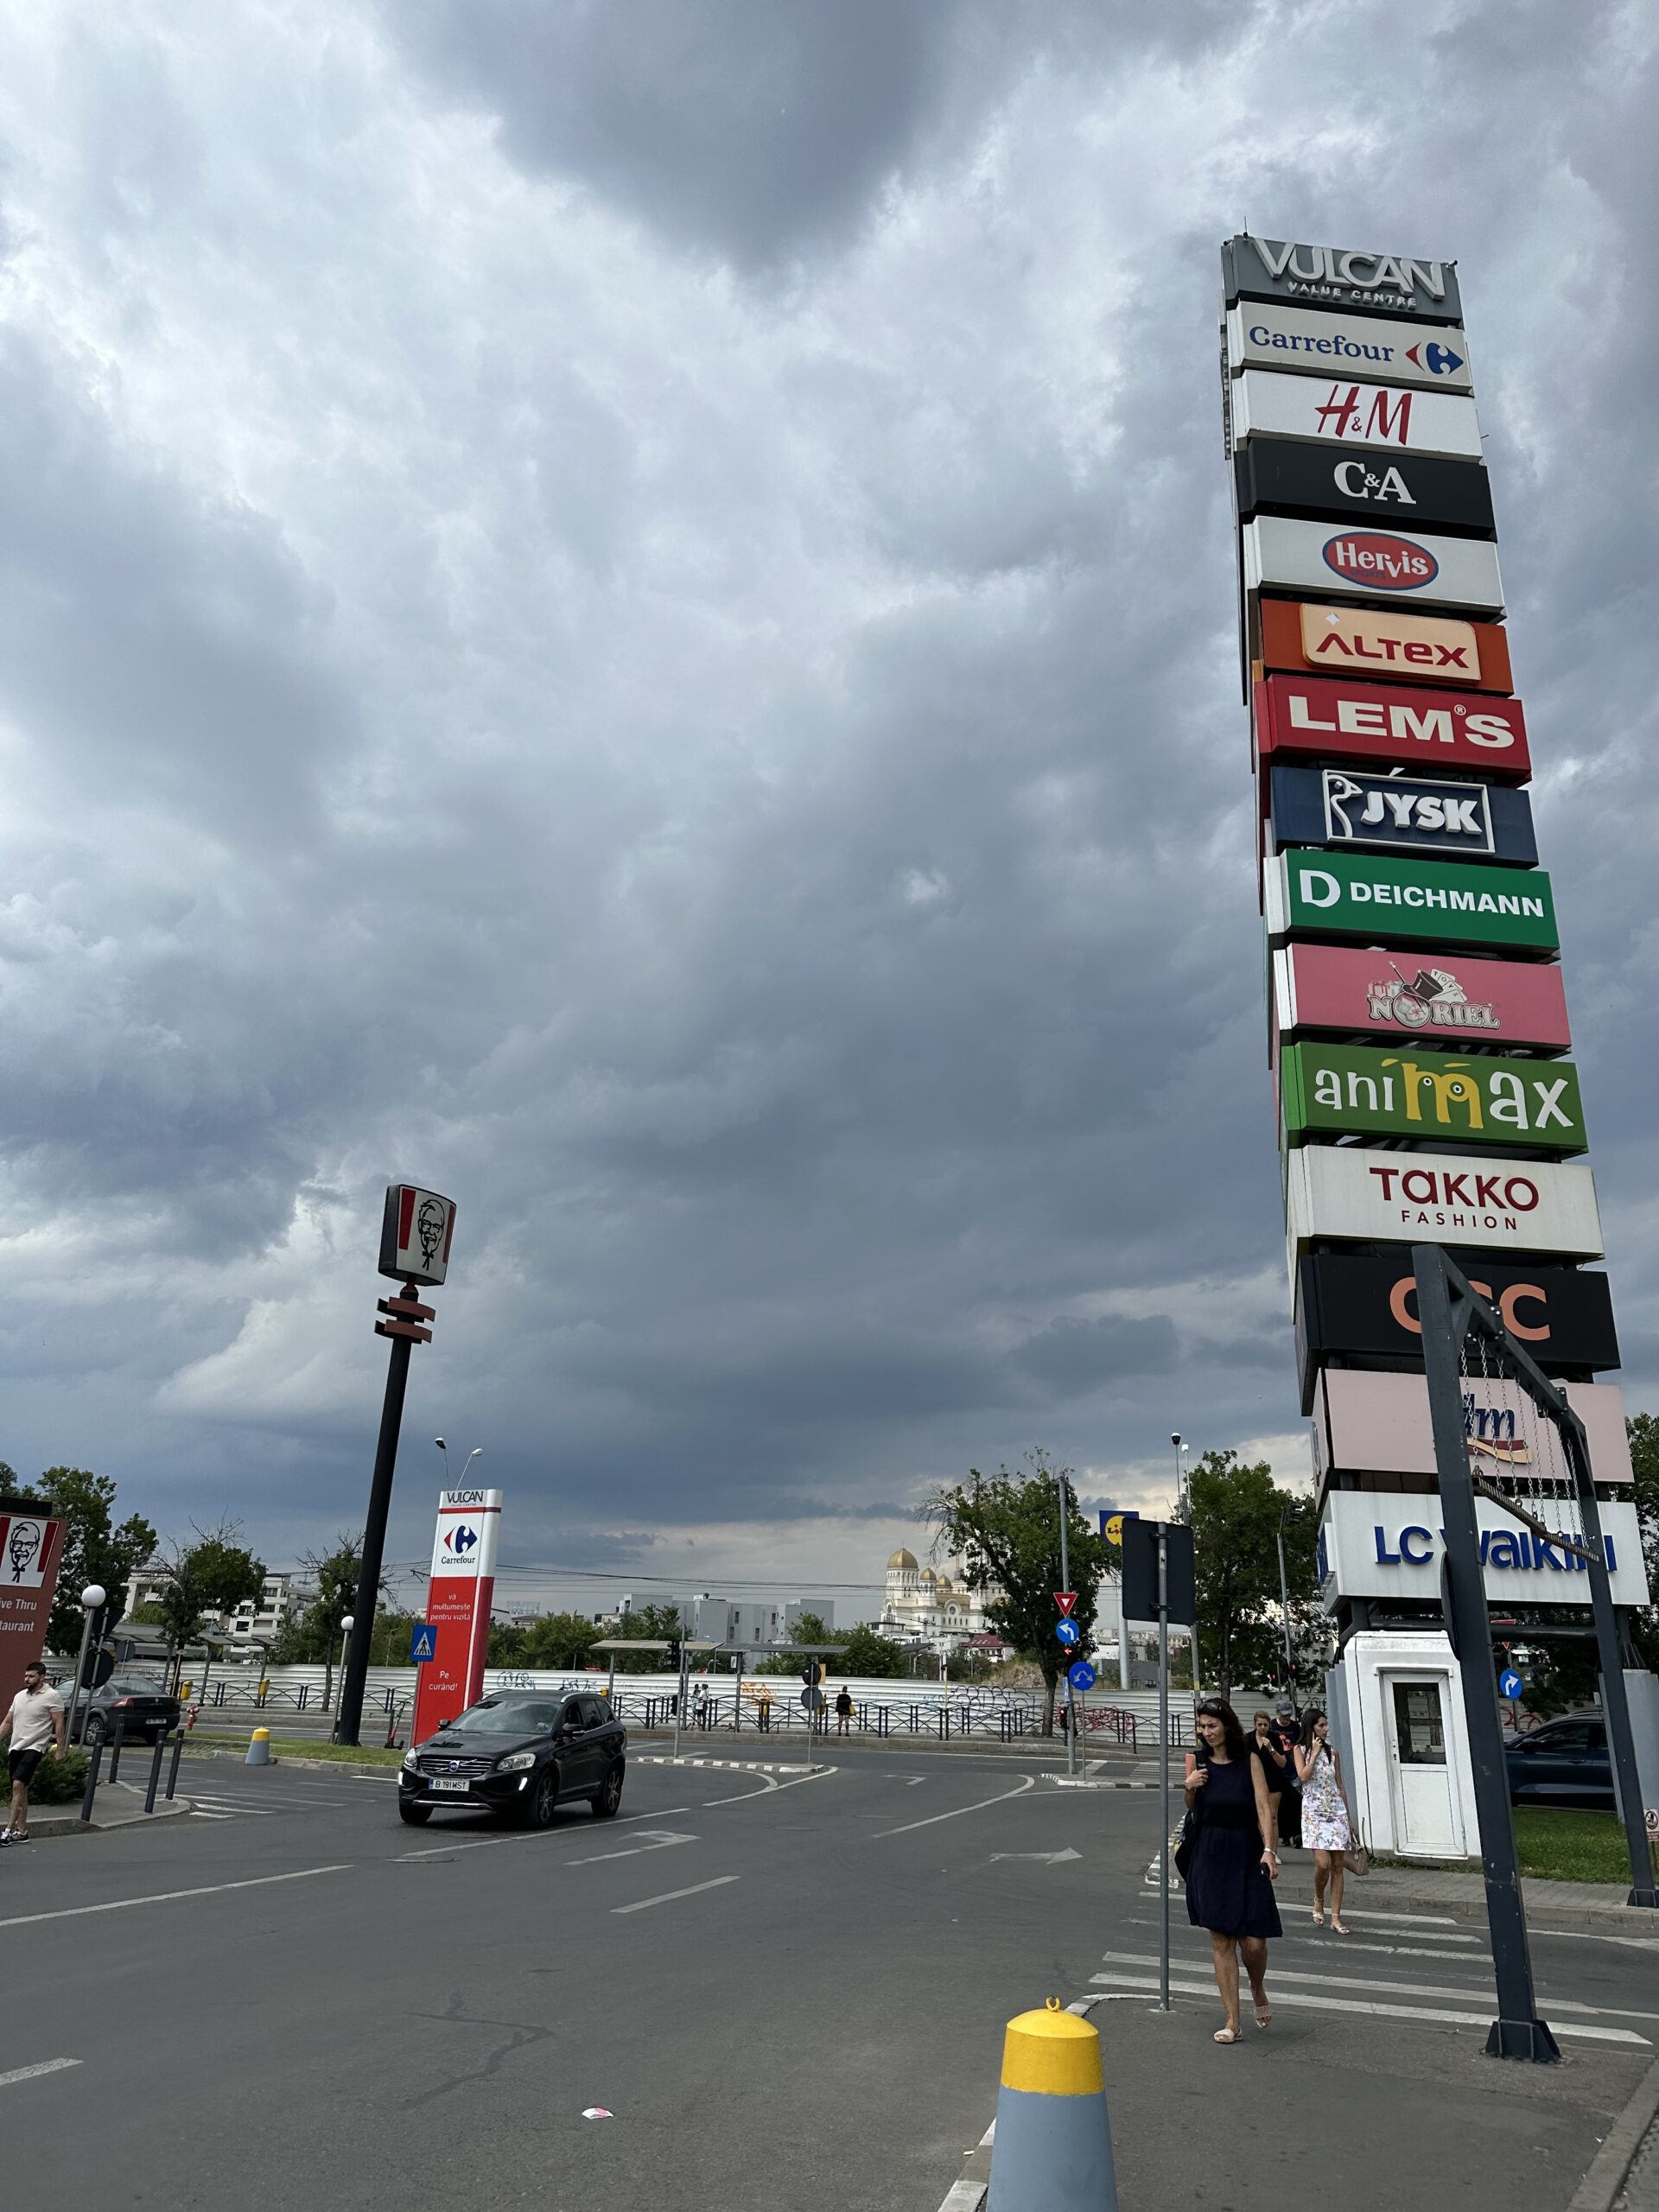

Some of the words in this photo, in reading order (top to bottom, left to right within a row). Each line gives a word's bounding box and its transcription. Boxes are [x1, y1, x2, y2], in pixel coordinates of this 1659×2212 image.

[1255, 238, 1445, 301] VULCAN
[1287, 282, 1341, 299] VALUE
[1351, 289, 1417, 309] CENTRE
[1249, 326, 1394, 362] Carrefour
[1314, 384, 1412, 446] H&M
[1333, 461, 1416, 504] C&A
[1335, 541, 1429, 578] Hervis
[1361, 791, 1483, 835] JYSK
[1350, 881, 1545, 918] DEICHMANN
[1367, 992, 1502, 1029] NORIEL
[1314, 1059, 1575, 1130] animax
[1401, 1210, 1517, 1230] FASHION
[447, 1491, 484, 1503] VULCAN
[441, 1555, 476, 1565] Carrefour
[1374, 1525, 1434, 1565] LC
[16, 1599, 37, 1611] Thru
[439, 1670, 449, 1679] Pe
